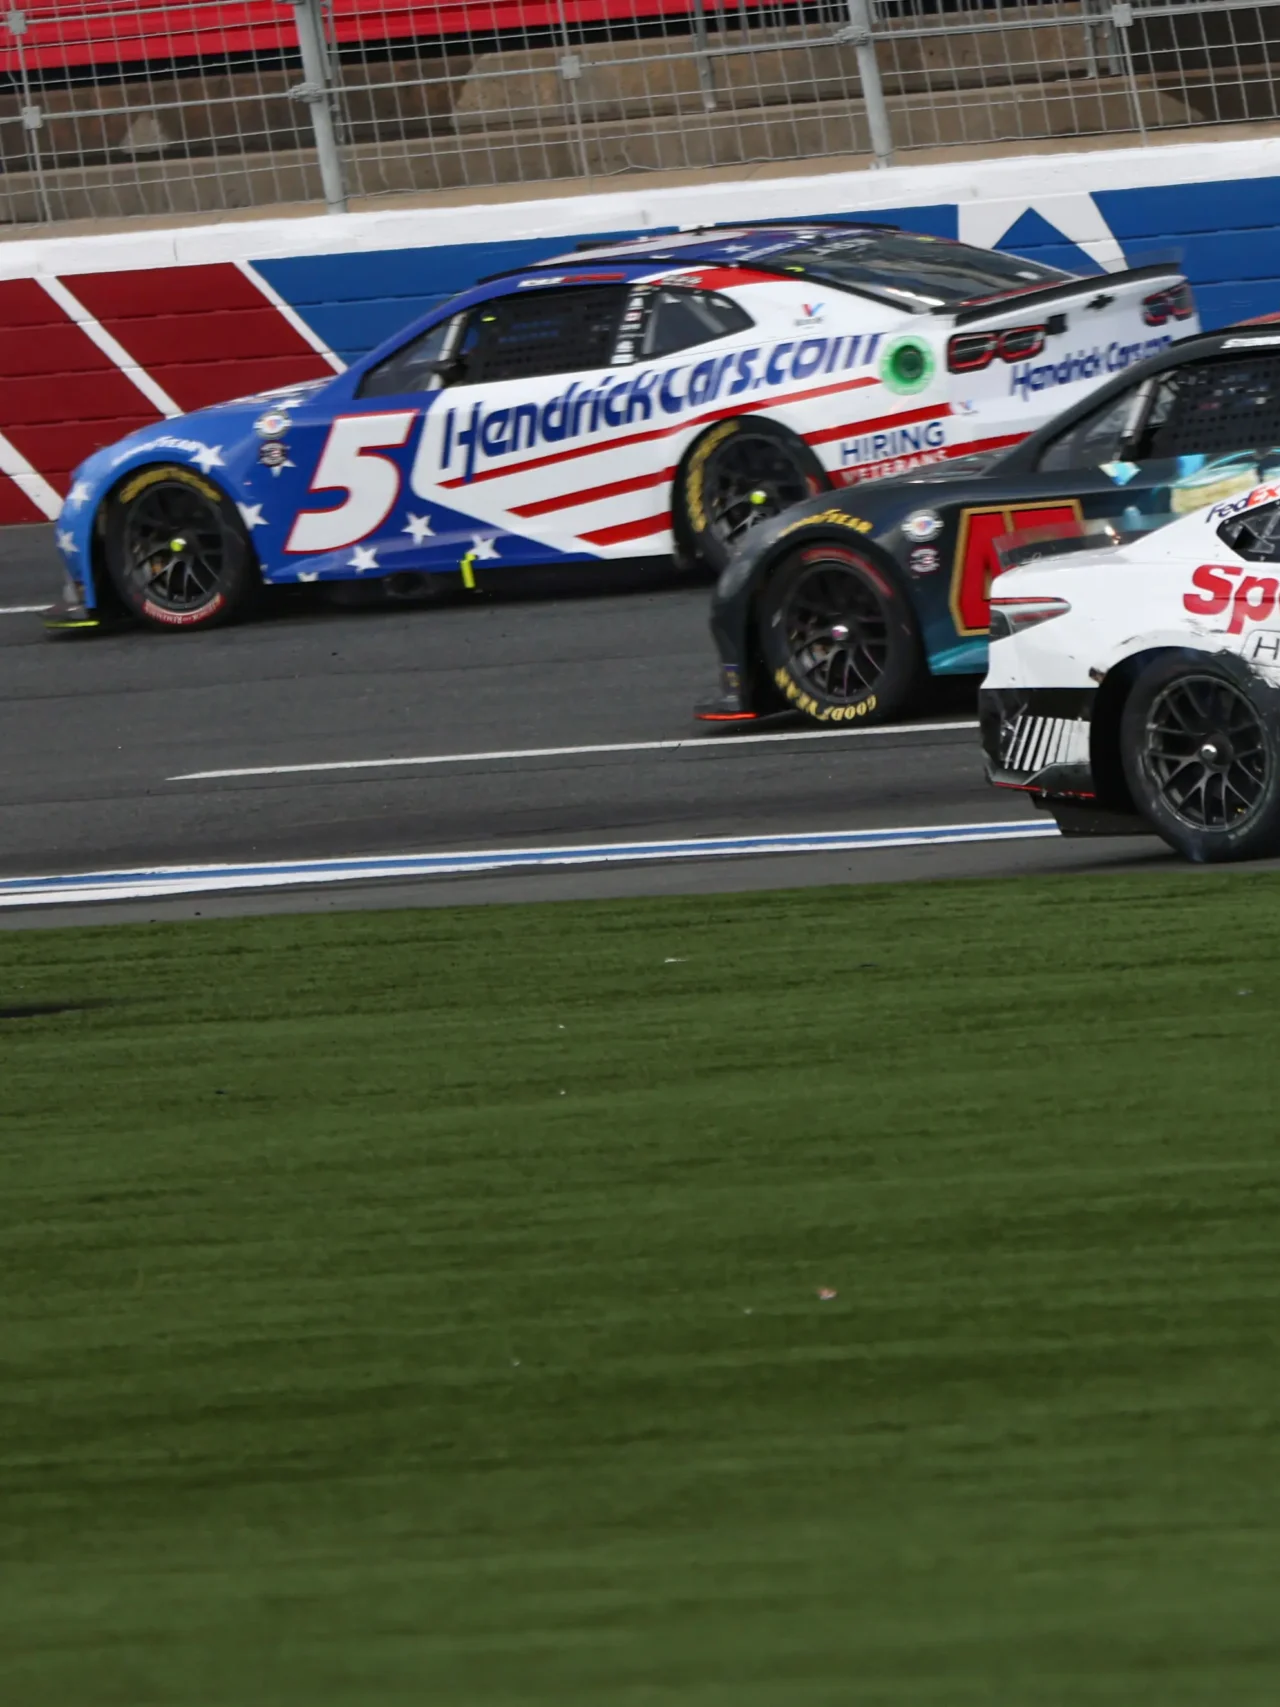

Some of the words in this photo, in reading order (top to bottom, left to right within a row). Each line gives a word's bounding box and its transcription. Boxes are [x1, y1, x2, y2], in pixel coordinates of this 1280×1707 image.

[440, 332, 887, 483] HendrickCars.com
[840, 421, 946, 465] HIRING
[284, 408, 419, 554] 5
